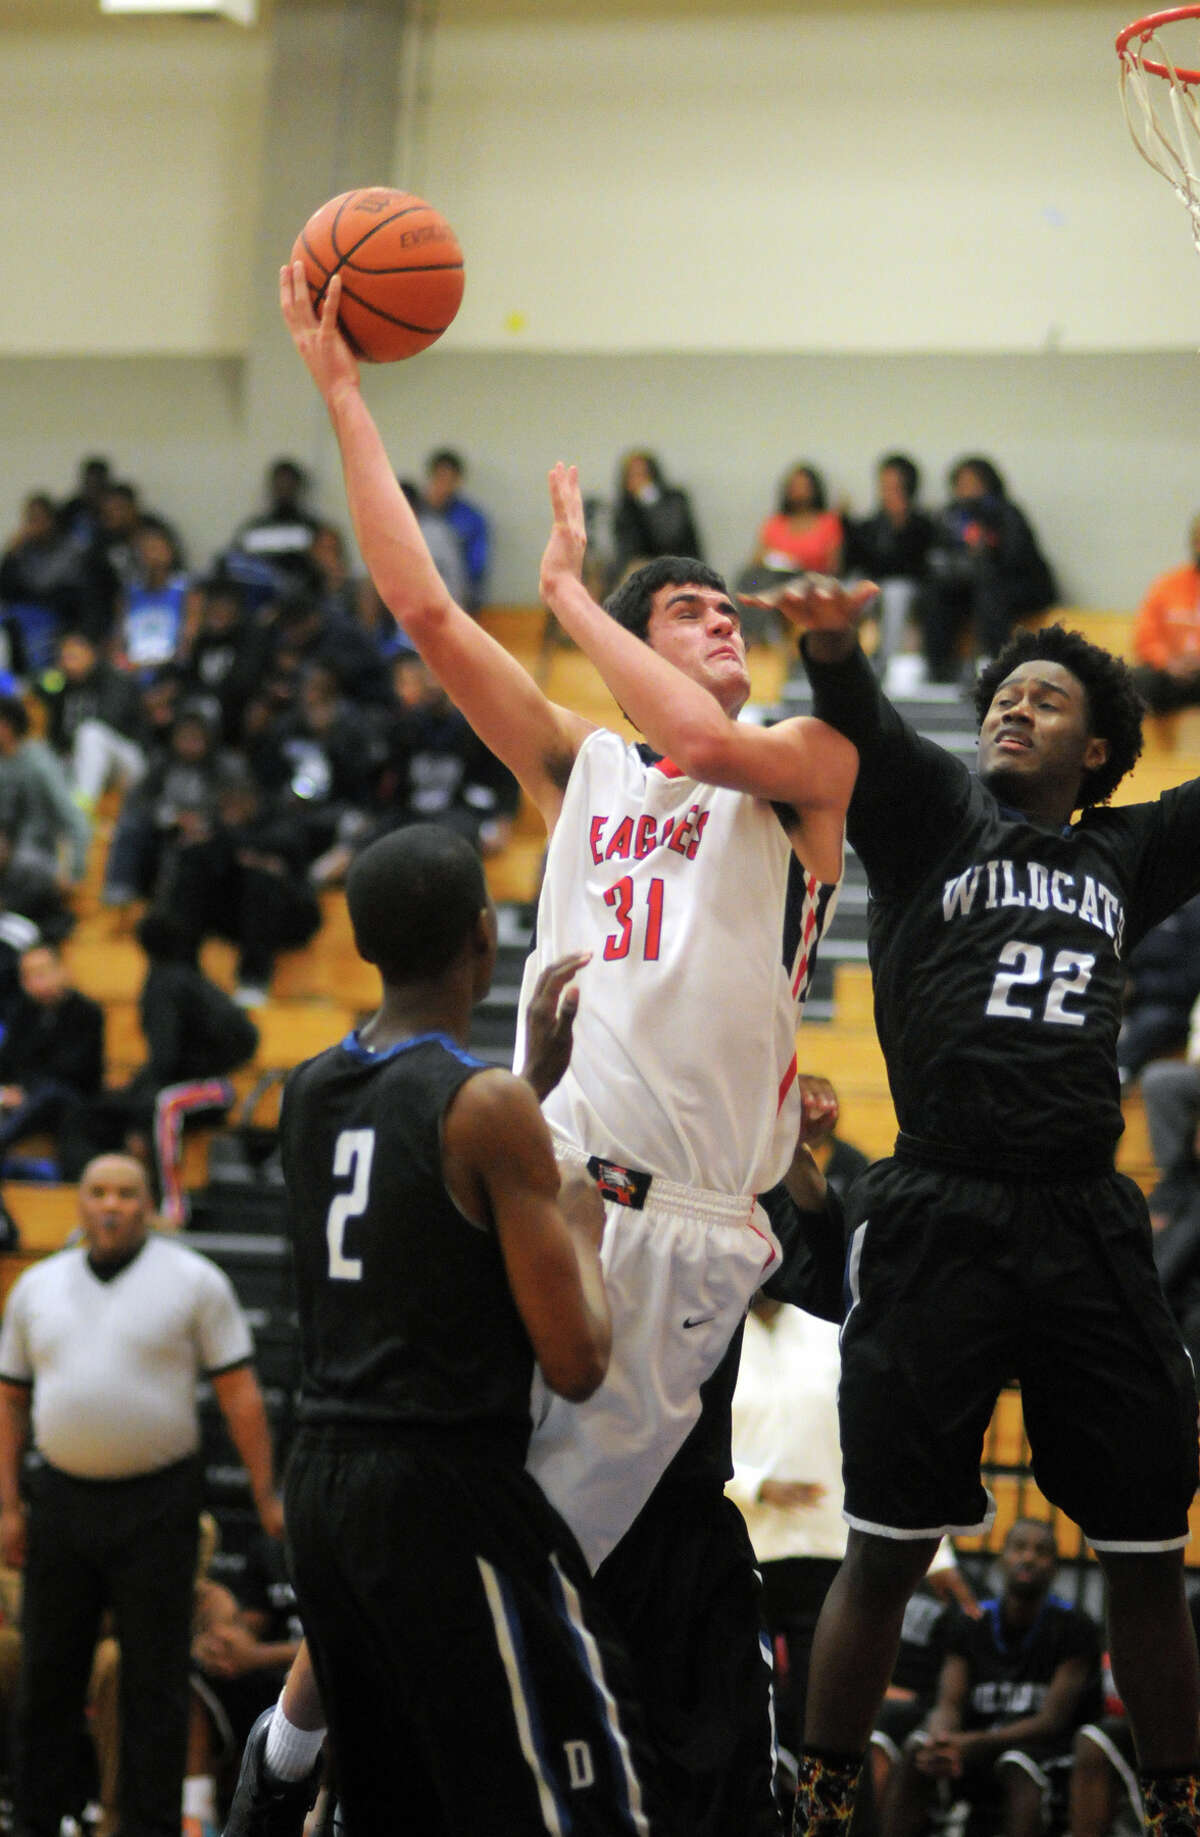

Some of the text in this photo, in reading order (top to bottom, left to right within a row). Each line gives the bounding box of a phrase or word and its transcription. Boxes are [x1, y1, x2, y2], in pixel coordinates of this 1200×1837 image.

[603, 876, 664, 961] 31
[986, 941, 1095, 1026] 22
[326, 1128, 375, 1280] 2
[563, 1741, 594, 1789] D
